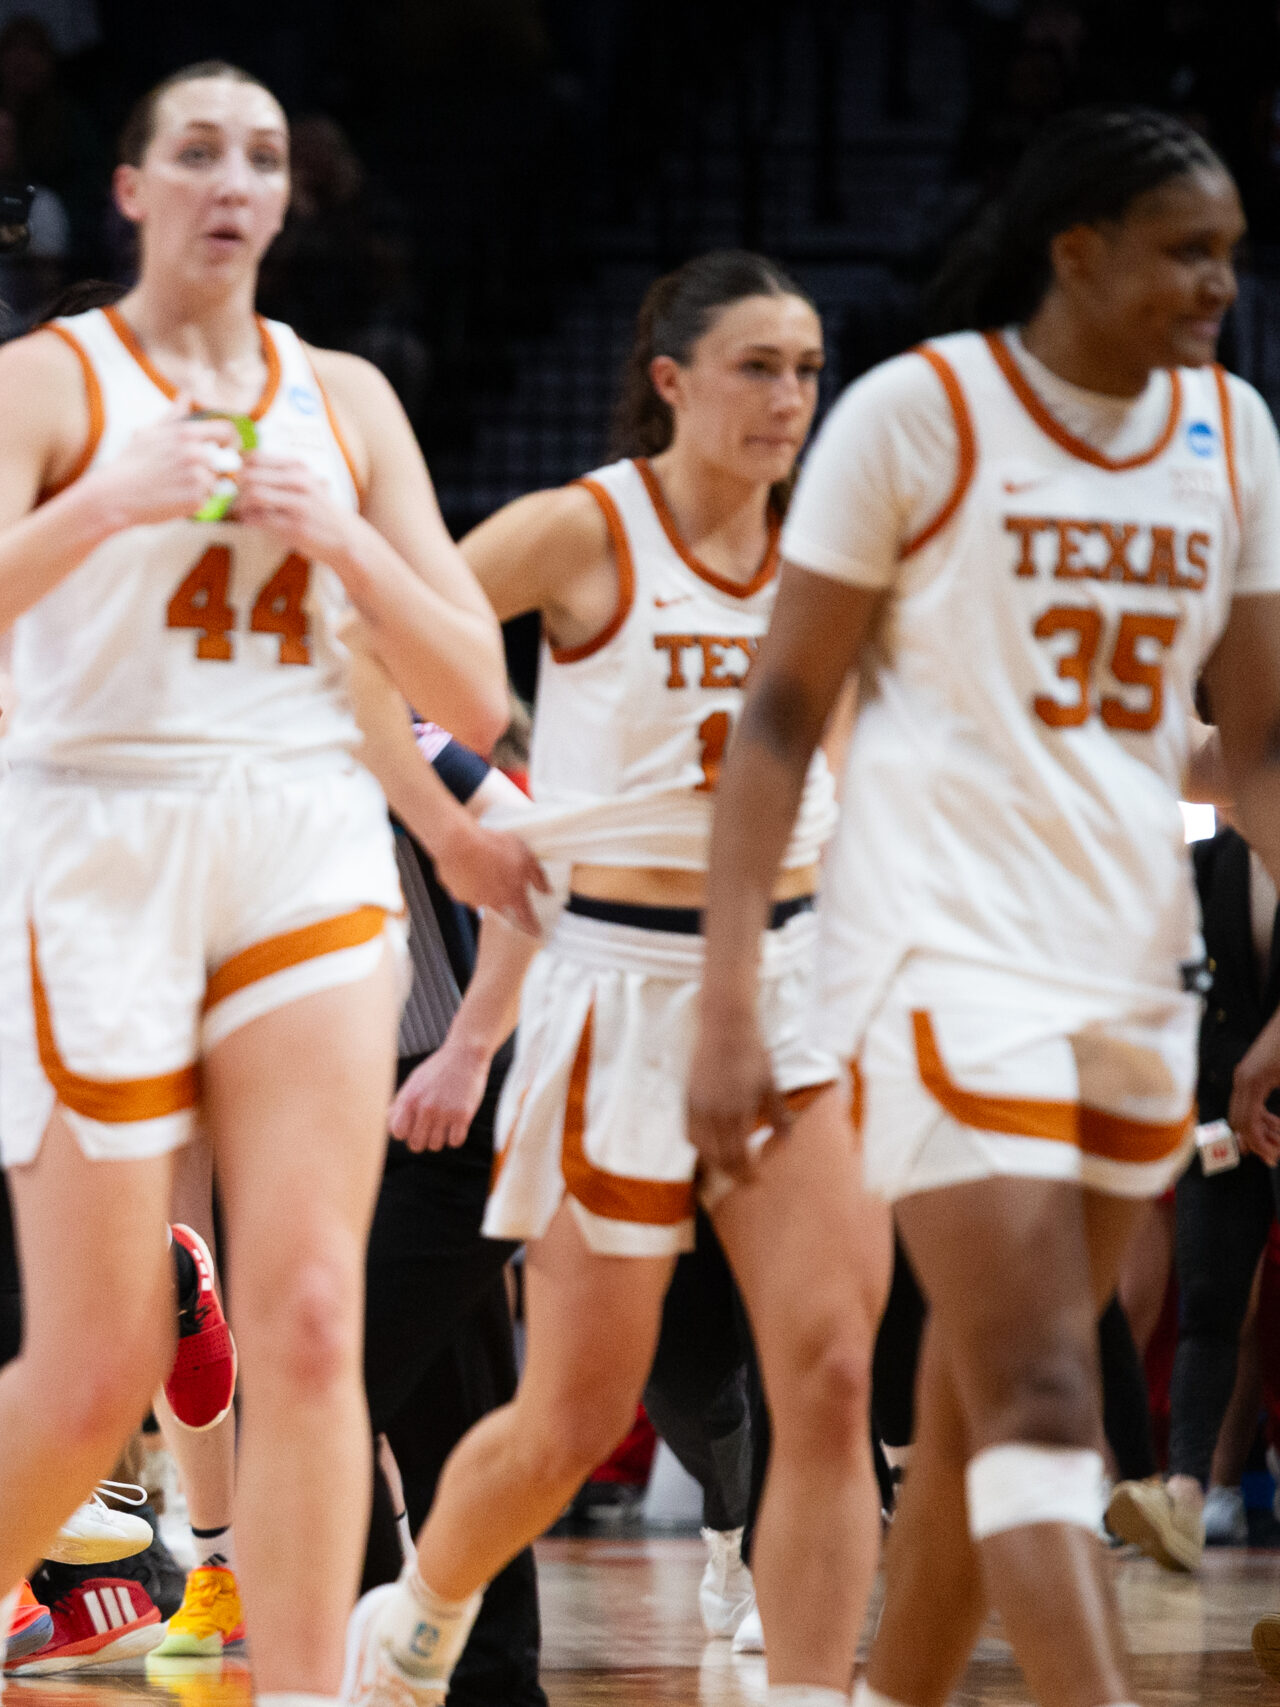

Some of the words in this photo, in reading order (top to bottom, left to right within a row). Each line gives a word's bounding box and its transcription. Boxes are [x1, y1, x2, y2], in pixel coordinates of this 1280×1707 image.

[164, 542, 311, 665] 44
[1004, 514, 1211, 592] TEXAS
[1032, 605, 1179, 732] 35
